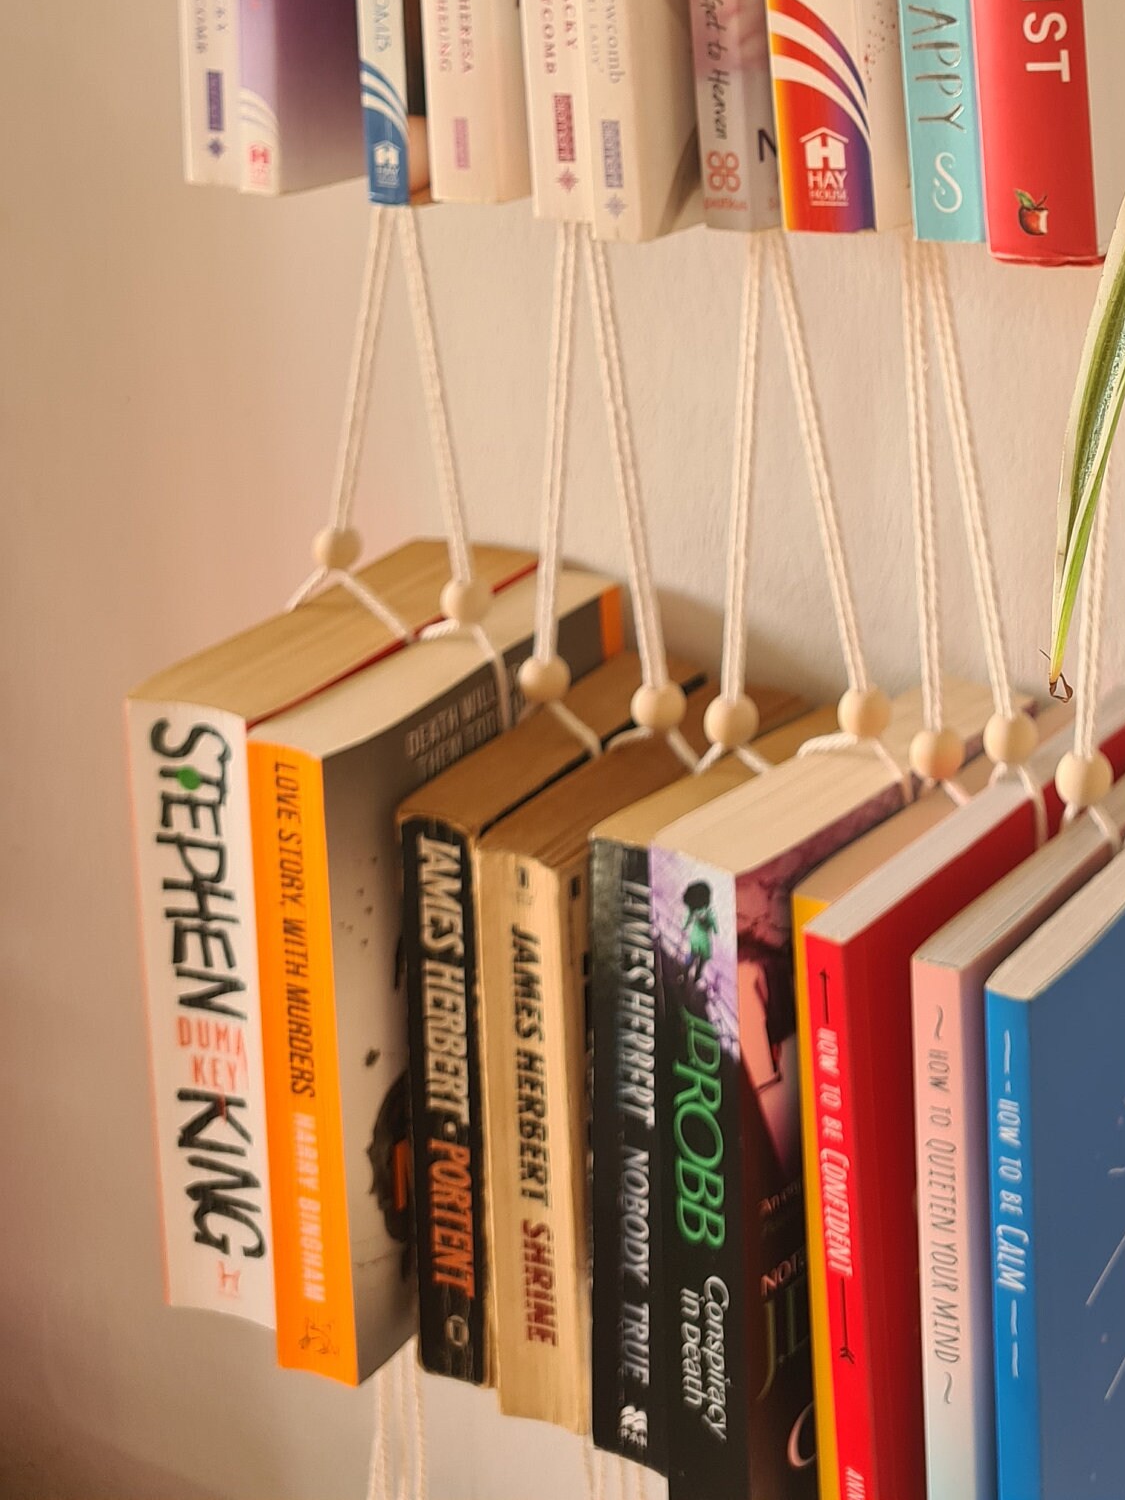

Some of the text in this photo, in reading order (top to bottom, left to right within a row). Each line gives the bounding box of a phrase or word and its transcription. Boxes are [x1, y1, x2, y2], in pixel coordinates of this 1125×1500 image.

[706, 40, 729, 66] to
[707, 68, 731, 140] Heaven
[807, 170, 848, 189] HAY
[149, 717, 267, 1260] STEPHEN KING
[273, 760, 316, 1098] LOVE STORY, WITH MURDERS
[177, 1015, 248, 1062] DUMA
[191, 1054, 239, 1094] KEY
[416, 832, 476, 1300] JAMES HERBERT PORTENT
[617, 879, 656, 1388] JAMES HERBERT NOBODY TRUE
[292, 1111, 327, 1304] HARRY BINGHAM
[510, 923, 559, 1348] JAMES HERBERT SHRINE
[670, 1058, 727, 1250] ROBB
[816, 1026, 854, 1278] HOW TO BE CONFIDENT
[925, 1047, 962, 1365] HOW TO QUIETEN YOUR MIND
[994, 1096, 1031, 1295] HOW TO BE CALM
[679, 1286, 707, 1411] in Death
[701, 1274, 736, 1444] Conspiracy
[844, 1465, 868, 1500] ANN
